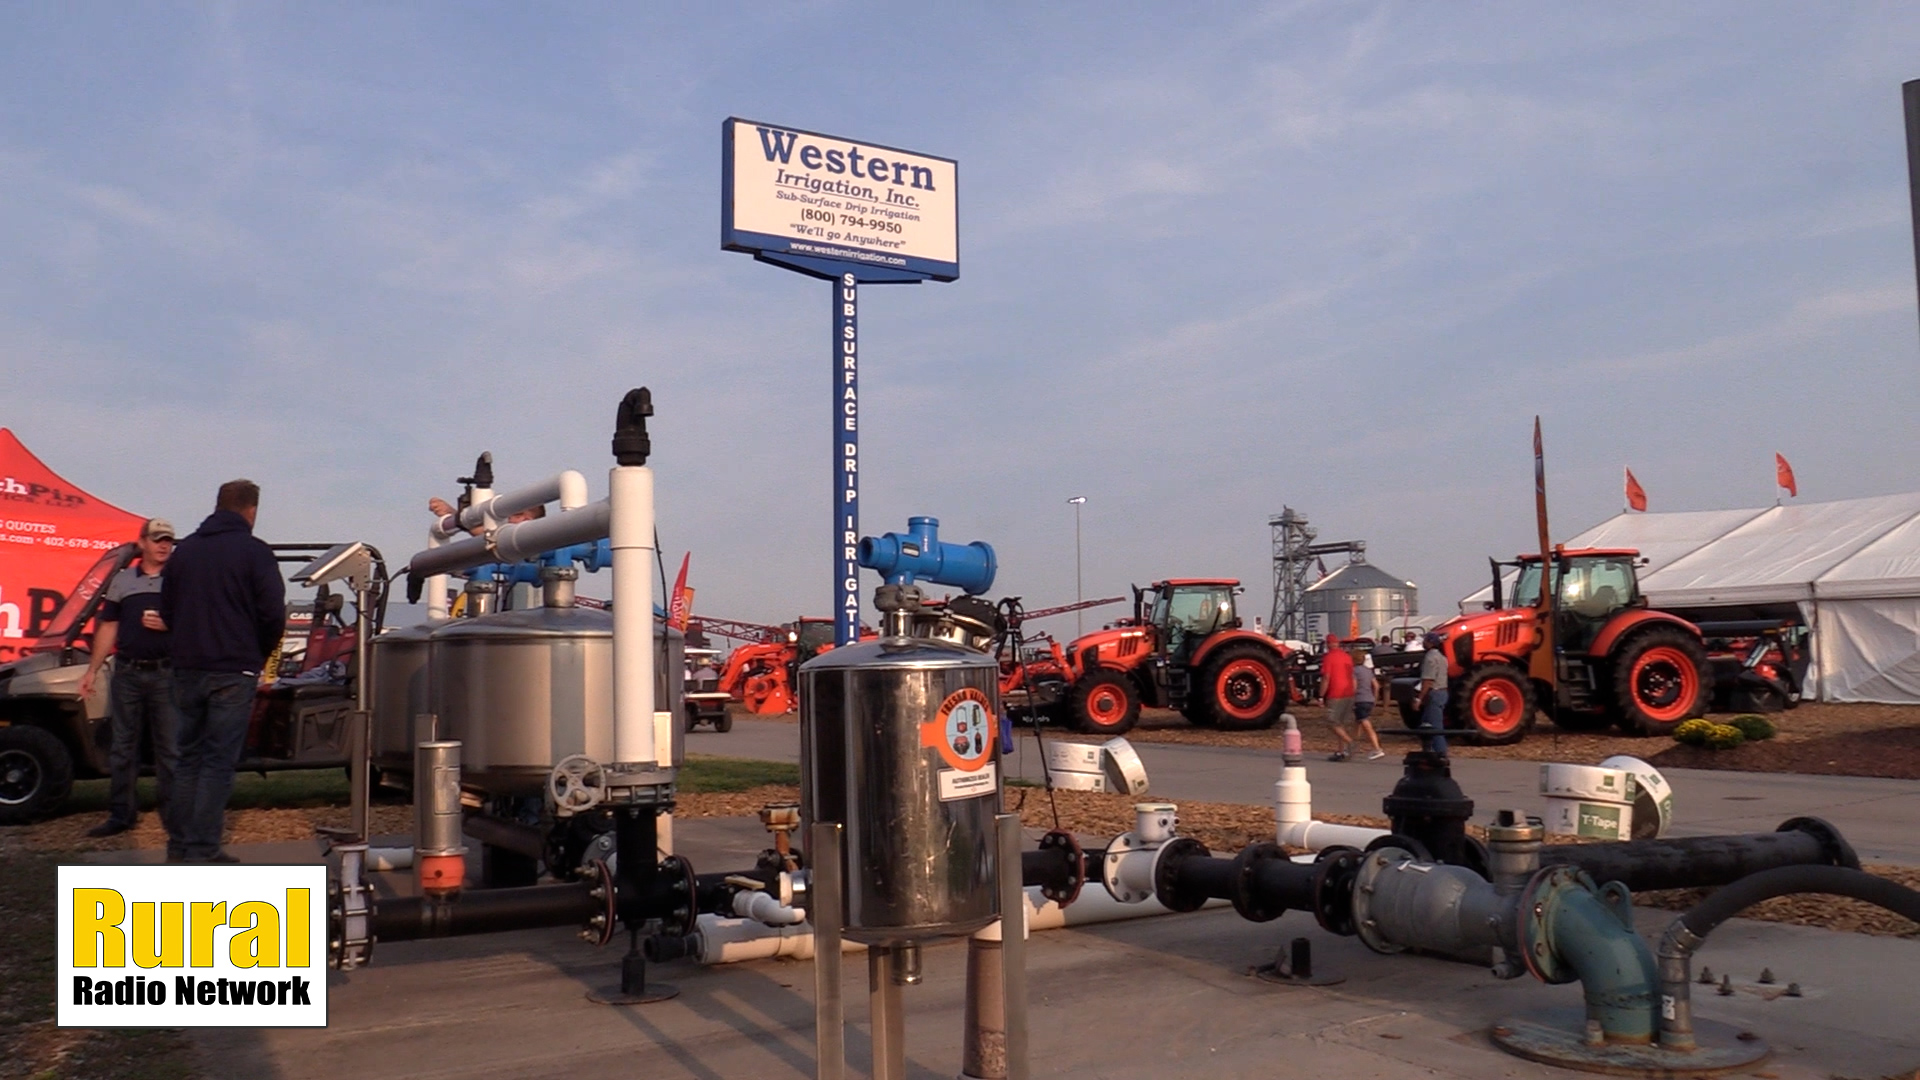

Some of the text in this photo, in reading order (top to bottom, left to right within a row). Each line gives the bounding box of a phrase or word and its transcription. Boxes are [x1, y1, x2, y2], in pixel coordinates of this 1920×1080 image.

[756, 127, 936, 191] Western
[775, 169, 920, 208] Irrigation, Inc.
[776, 190, 920, 222] Sub-Surface Drip Irrigation
[801, 208, 903, 235] (800) 794-9950
[789, 241, 907, 266] www.westernirrigation.com
[827, 231, 841, 241] go
[844, 232, 906, 249] Anywhere"
[844, 443, 857, 503] DRIP
[0, 477, 85, 504] hPin
[5, 519, 56, 534] QUOTES
[844, 515, 857, 645] IRRIGATI
[1581, 814, 1618, 830] T-Tape
